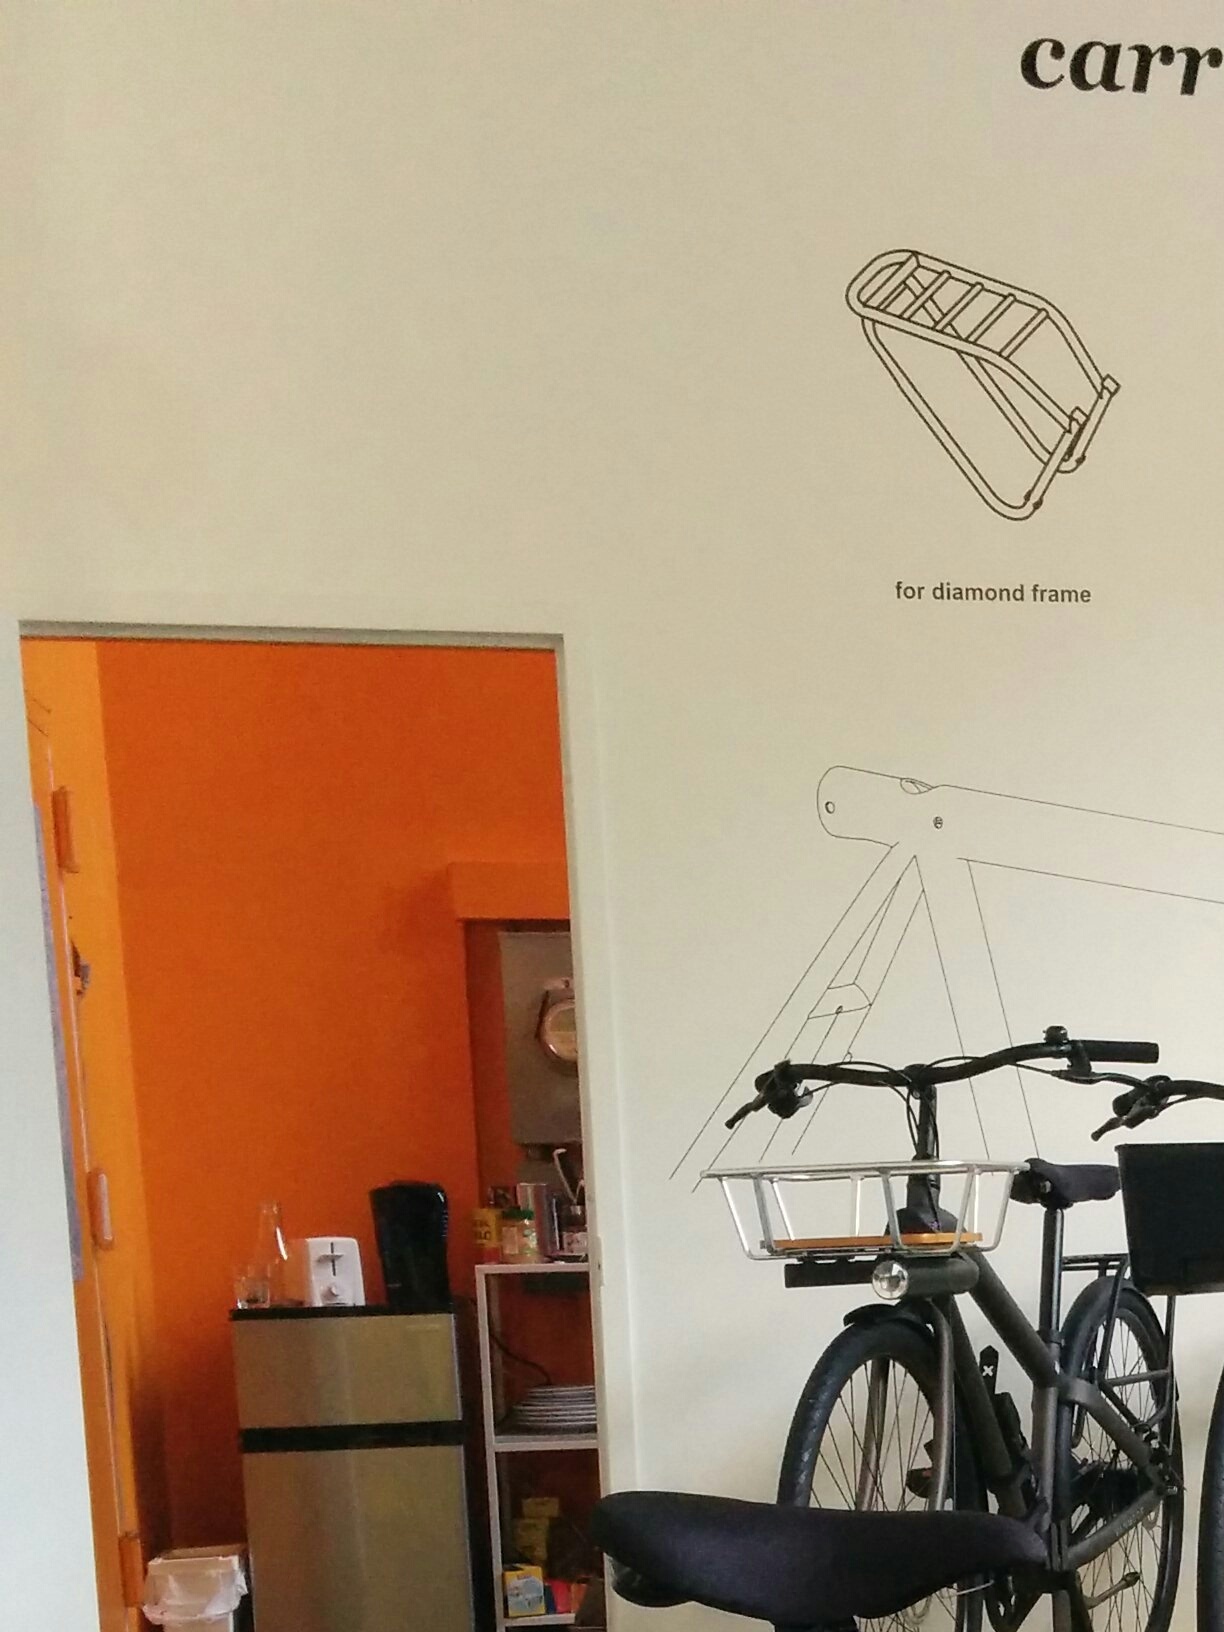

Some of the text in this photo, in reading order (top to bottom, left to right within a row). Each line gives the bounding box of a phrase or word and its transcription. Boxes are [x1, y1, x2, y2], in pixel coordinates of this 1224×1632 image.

[895, 581, 1091, 603] for diamond frame
